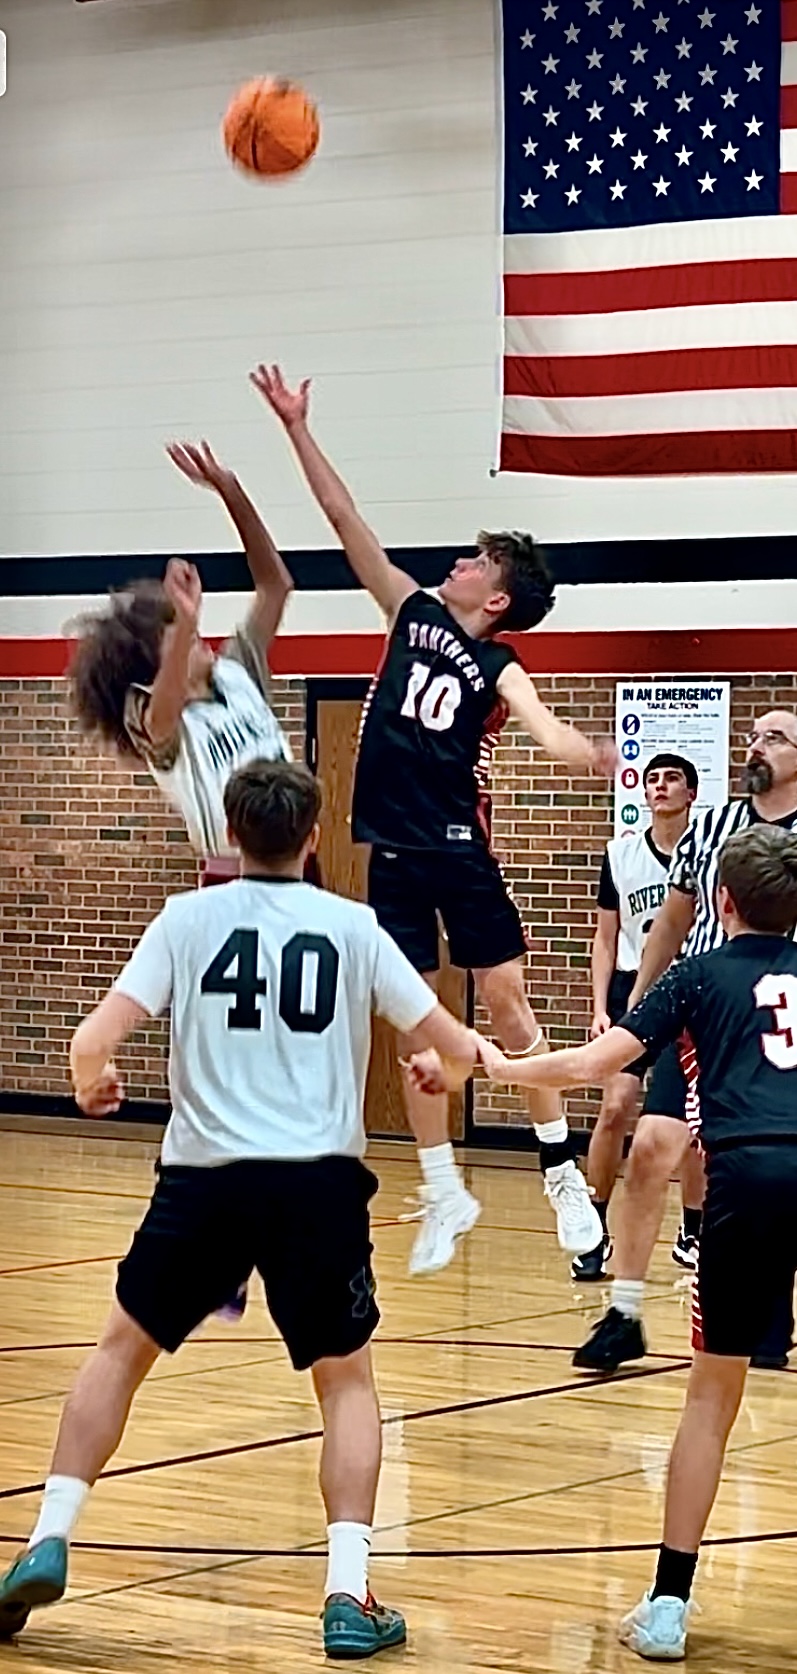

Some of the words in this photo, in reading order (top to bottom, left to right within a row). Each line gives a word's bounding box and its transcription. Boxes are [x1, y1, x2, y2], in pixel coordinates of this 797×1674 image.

[408, 621, 485, 692] PANTHERS
[400, 660, 461, 731] 10
[622, 688, 634, 701] IN
[636, 688, 652, 701] AN
[655, 688, 723, 701] EMERGENCY
[647, 702, 666, 710] TAKE
[668, 702, 698, 710] ACTION
[200, 927, 340, 1034] 40
[752, 973, 797, 1070] 3
